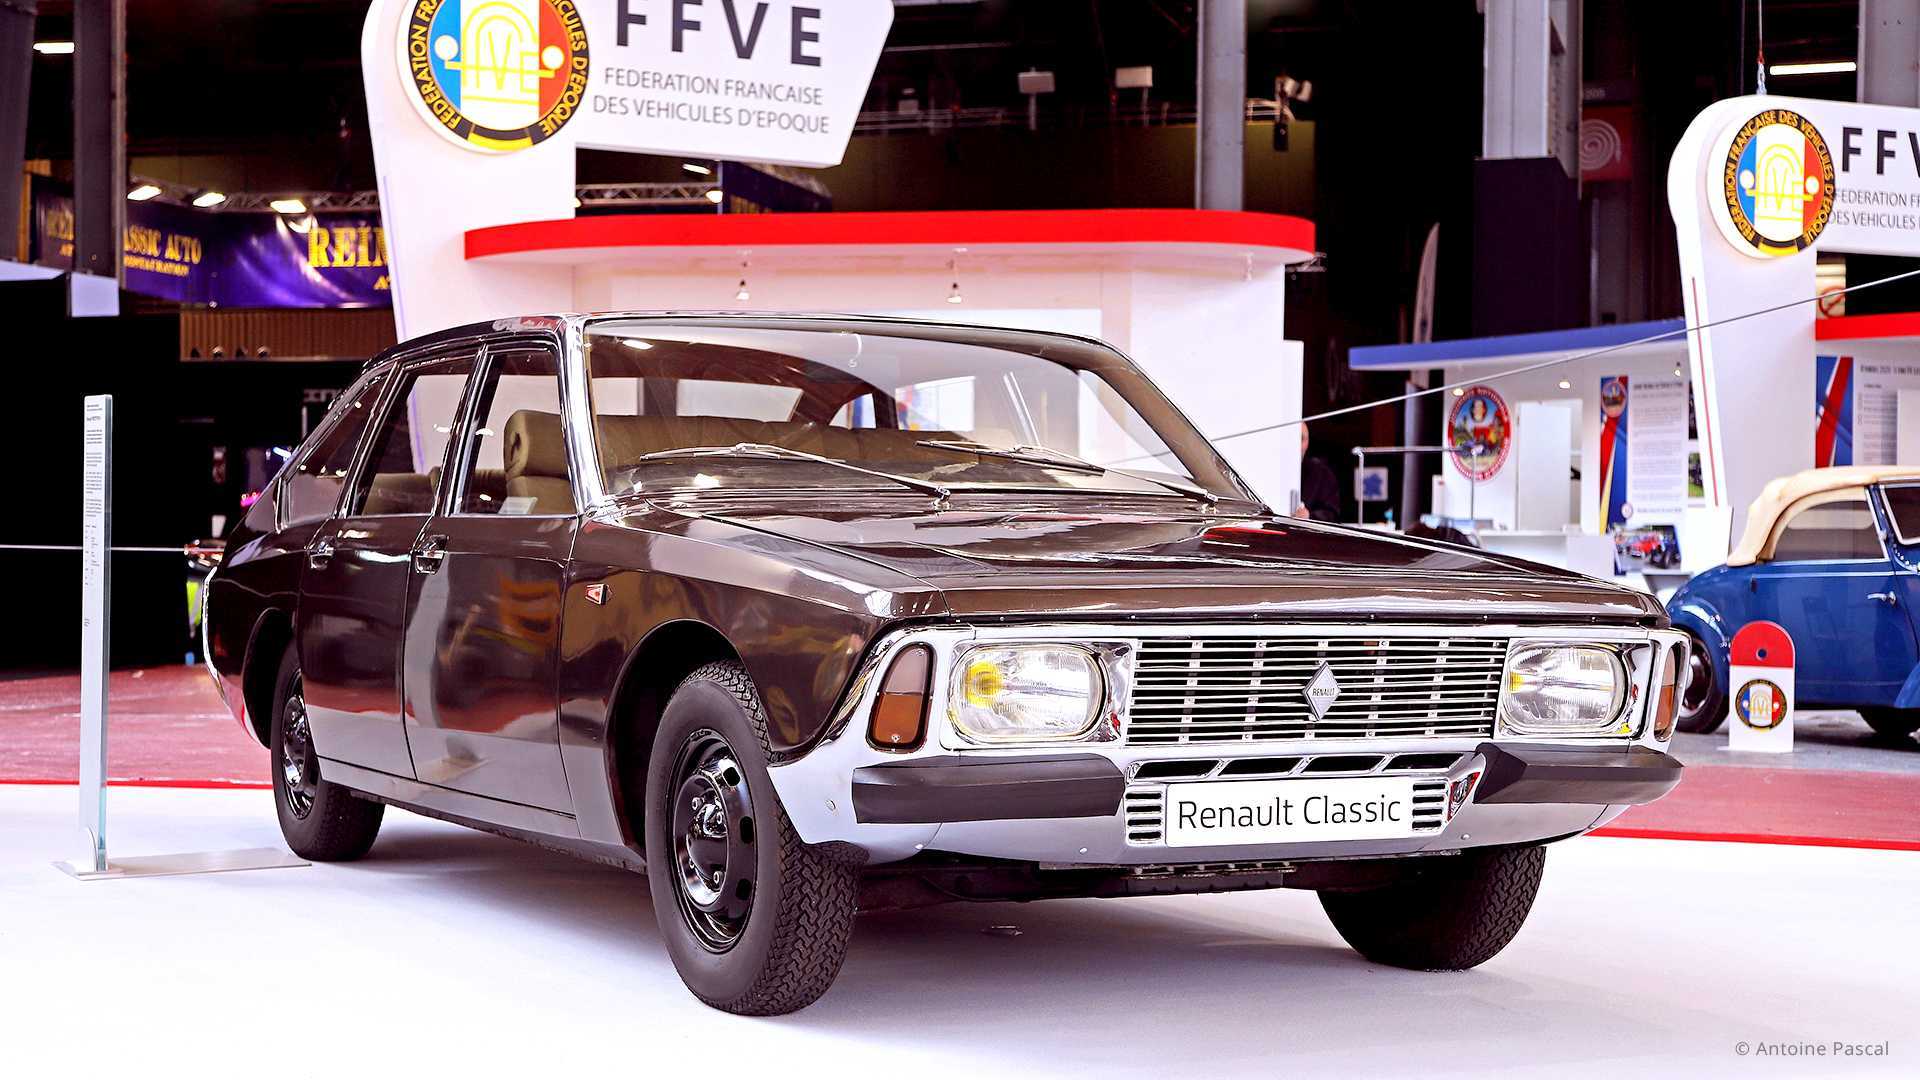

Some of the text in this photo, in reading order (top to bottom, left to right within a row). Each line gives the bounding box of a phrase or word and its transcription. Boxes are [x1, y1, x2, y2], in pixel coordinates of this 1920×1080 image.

[616, 0, 822, 67] FFVE
[410, 25, 462, 130] FEDERATION
[539, 56, 588, 136] D'EPOQUE
[604, 67, 823, 106] FEDERATION FRANCAISE
[593, 95, 829, 135] DES VEHICULES D'EPOQUE
[1780, 110, 1799, 127] DES
[1800, 119, 1834, 182] VEHICULES
[1852, 211, 1916, 230] VEHICULES
[165, 232, 201, 265] AUTO
[1178, 794, 1401, 829] Renault Classic
